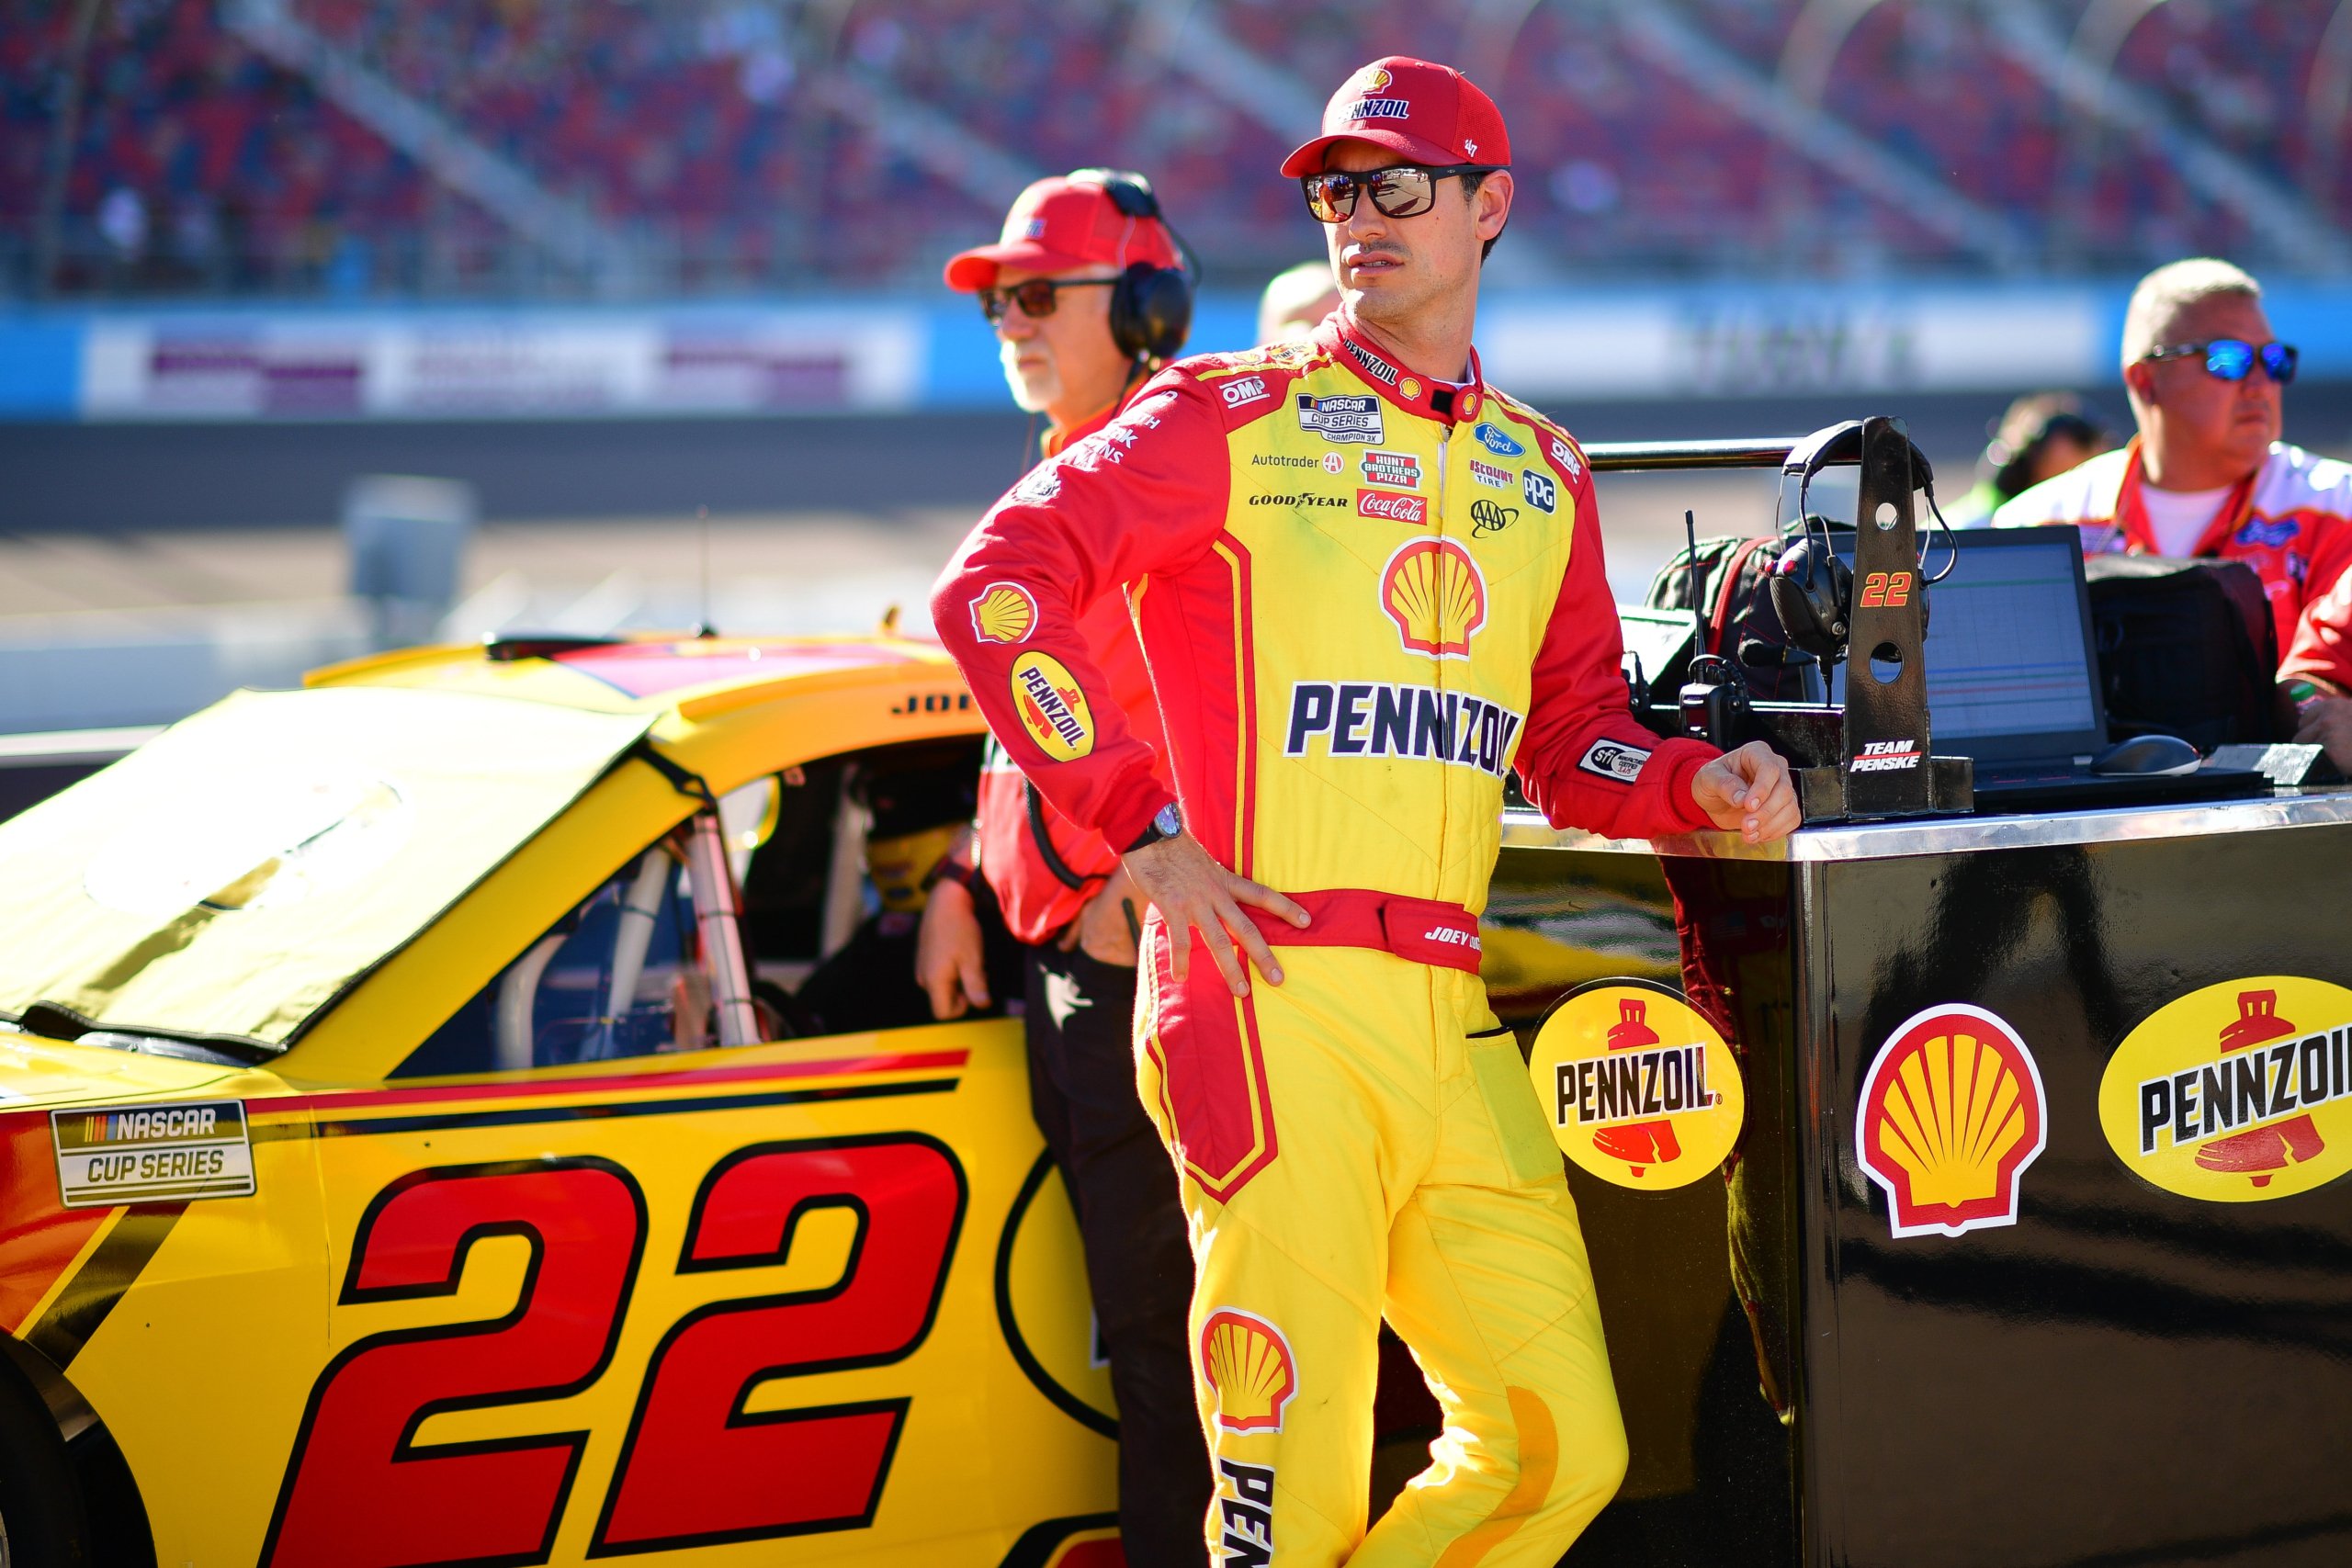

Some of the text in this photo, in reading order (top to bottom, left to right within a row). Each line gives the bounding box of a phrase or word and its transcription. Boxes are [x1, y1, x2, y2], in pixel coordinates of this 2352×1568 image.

[1339, 98, 1409, 121] NNZOIL
[1343, 338, 1398, 386] PENNZOIL
[1222, 378, 1266, 403] OMP
[1321, 399, 1366, 412] NASCAR
[1311, 413, 1369, 428] CUP SERIES
[1327, 433, 1376, 443] CHAMPION 3X
[1485, 426, 1512, 453] Ford
[1251, 454, 1319, 468] Autotrader
[1364, 462, 1419, 478] BROTHERS
[1375, 455, 1406, 468] HUNT
[1551, 441, 1581, 477] OMP
[1377, 472, 1408, 485] PIZZA
[1470, 459, 1513, 485] ISCOUNT
[1476, 475, 1501, 488] TIRE
[1249, 493, 1348, 508] GOODYEAR
[1524, 475, 1554, 507] PPG
[1360, 492, 1425, 523] Coca-Cola
[1476, 500, 1505, 530] AAA
[1860, 571, 1912, 608] 22
[1017, 665, 1088, 750] PENNZOIL
[1283, 681, 1524, 781] PENNZOIL
[1595, 749, 1616, 765] sfi
[1863, 739, 1915, 755] TEAM
[1849, 754, 1921, 773] PENSKE
[1424, 926, 1470, 946] JOEY
[1555, 1042, 1716, 1128] PENNZOIL
[117, 1108, 217, 1141] NASCAR
[87, 1149, 224, 1183] CUP SERIES
[256, 1130, 970, 1568] 22
